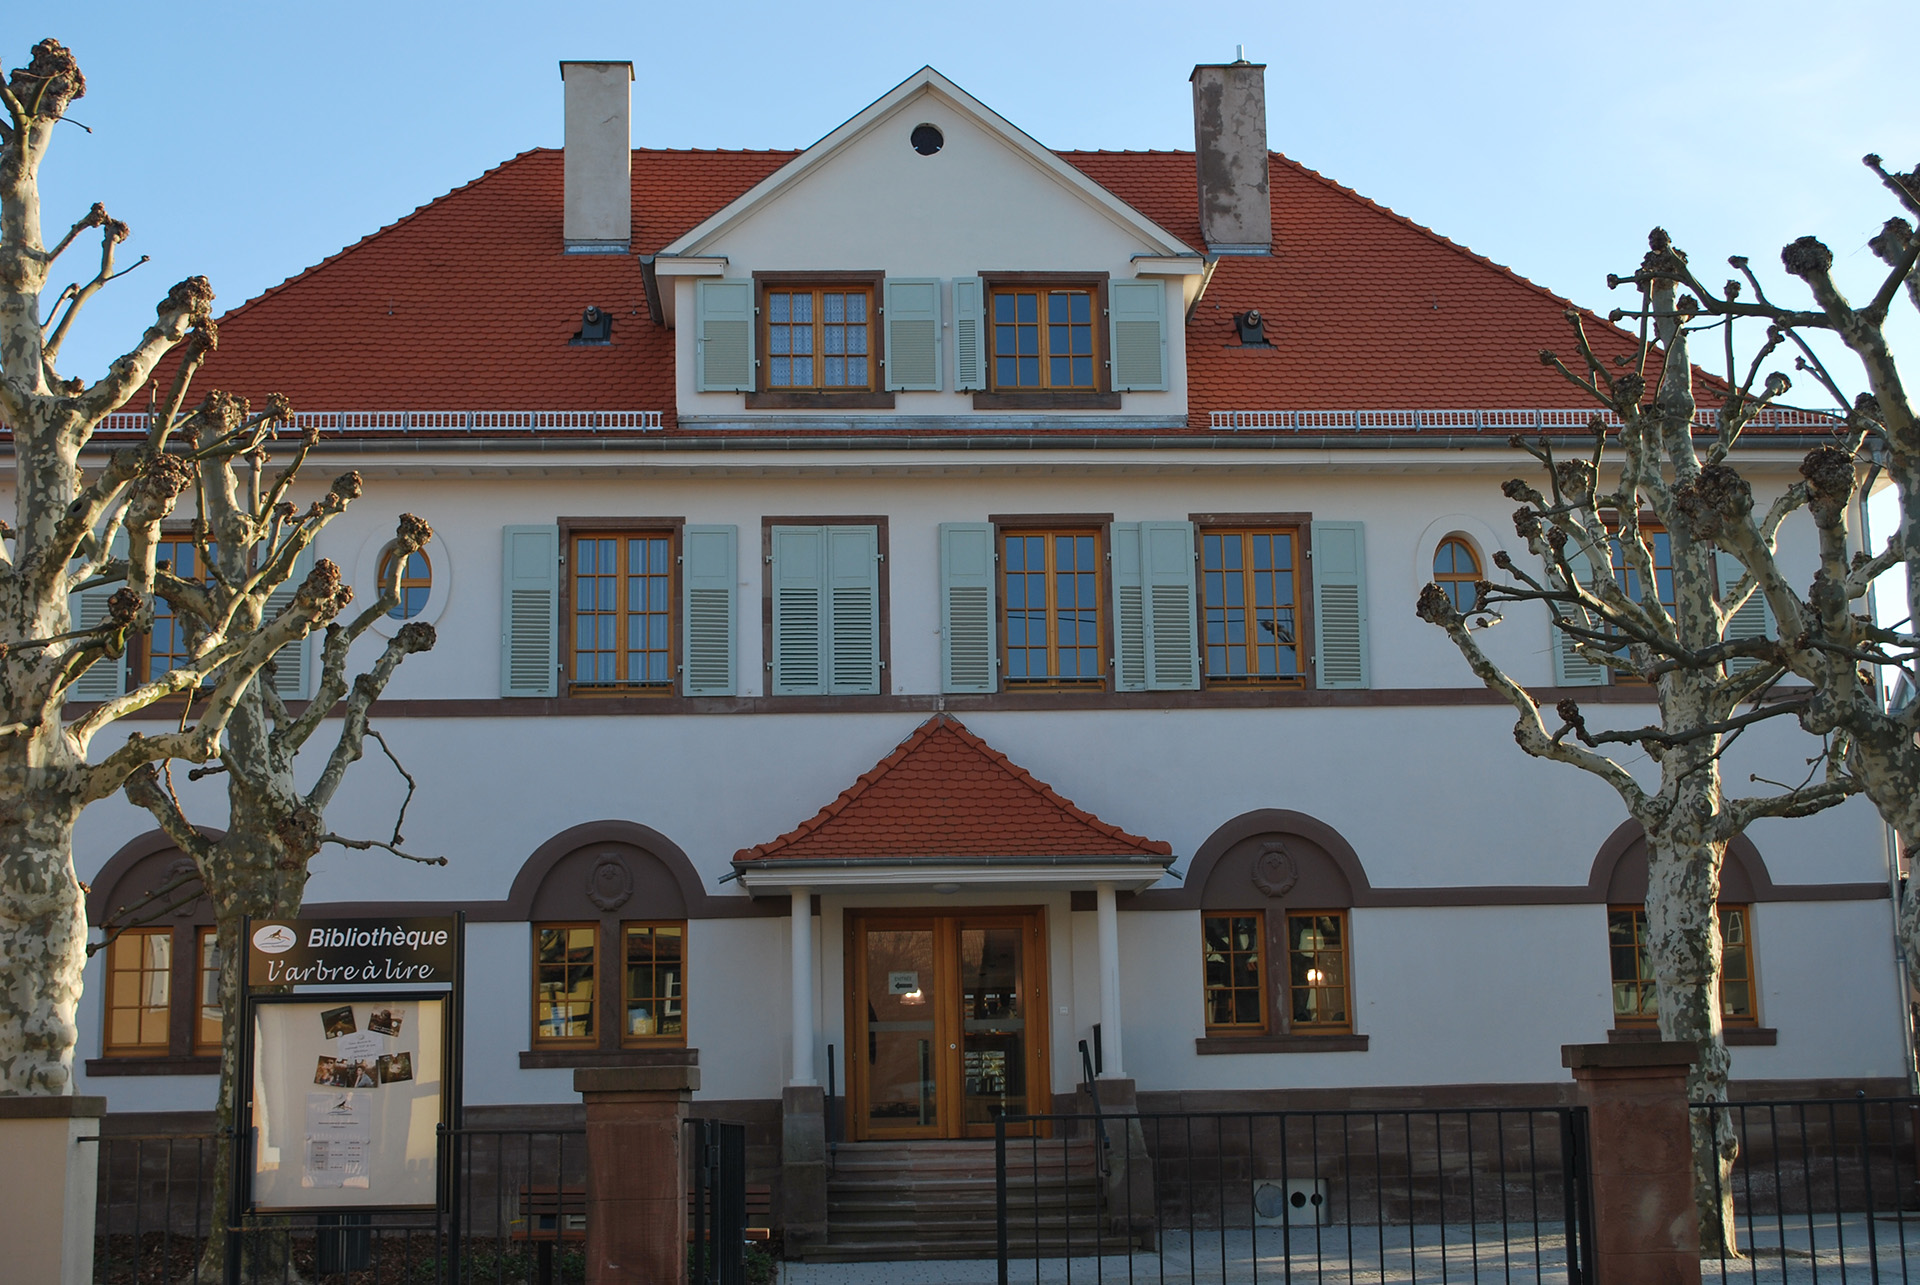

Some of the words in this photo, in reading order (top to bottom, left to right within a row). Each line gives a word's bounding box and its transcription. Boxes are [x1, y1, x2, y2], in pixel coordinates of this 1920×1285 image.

[307, 925, 448, 951] Bibliothèque
[267, 959, 360, 982] l'arbre
[362, 959, 382, 981] à
[384, 958, 435, 980] lire
